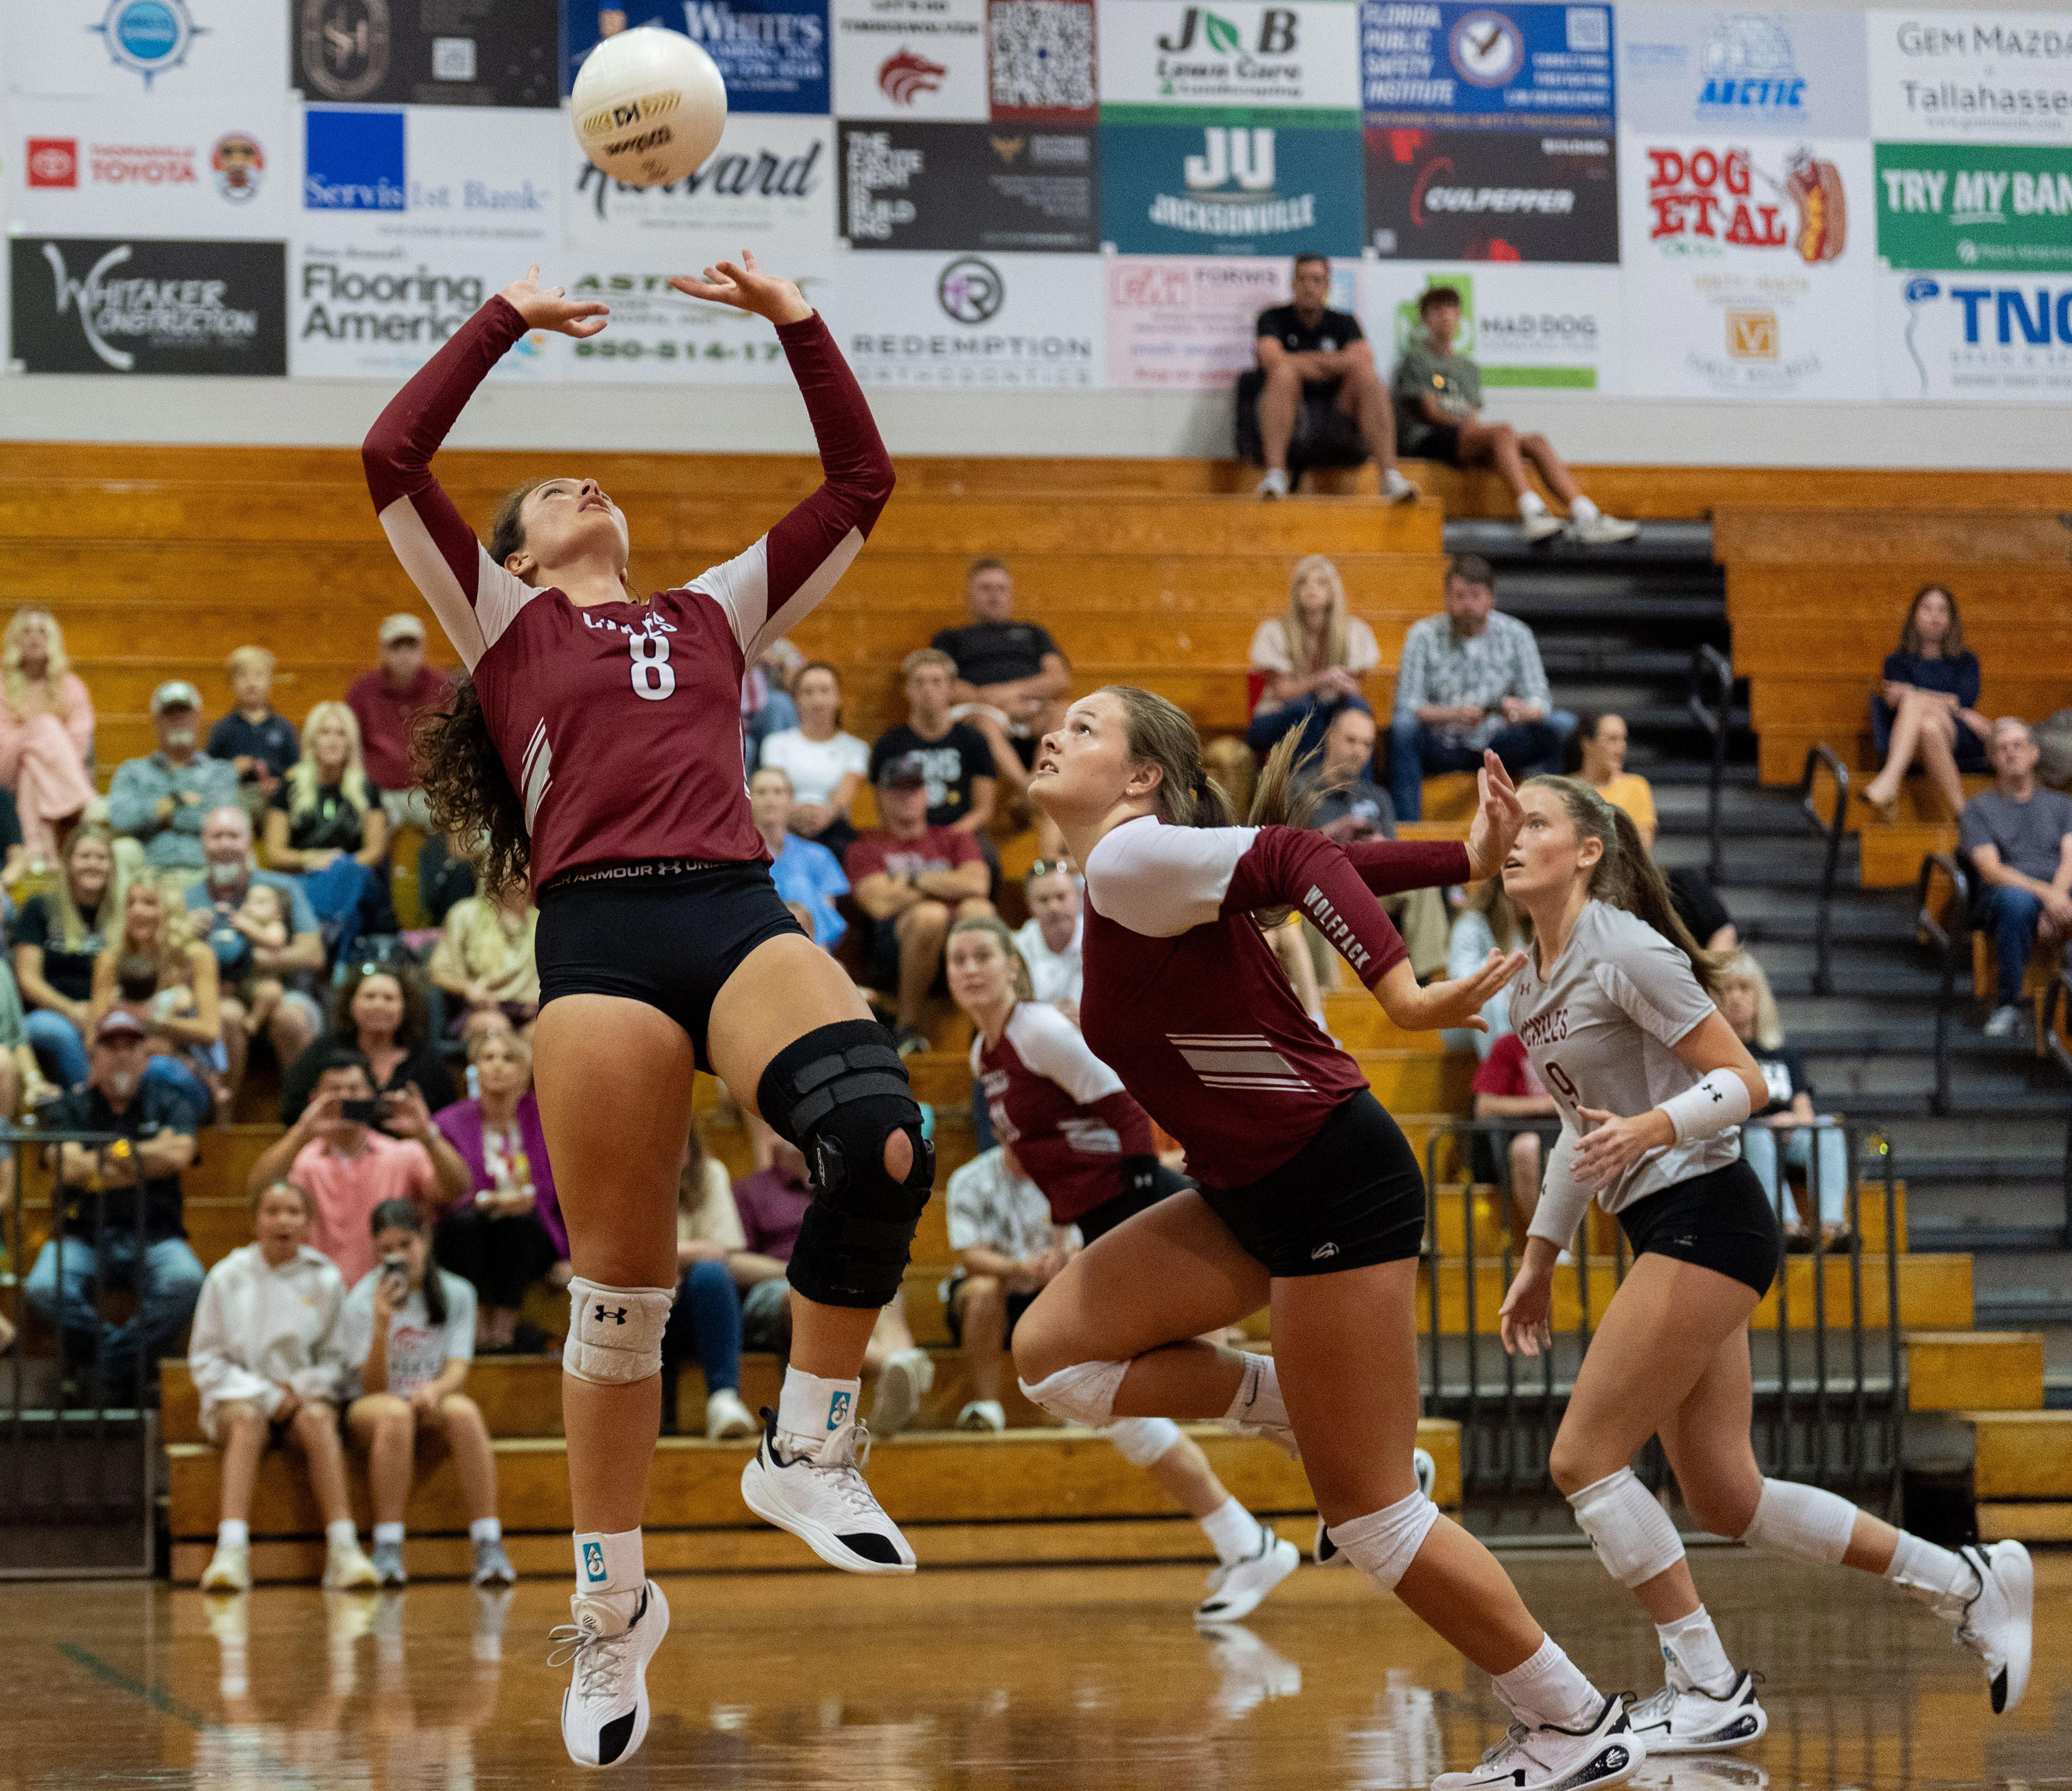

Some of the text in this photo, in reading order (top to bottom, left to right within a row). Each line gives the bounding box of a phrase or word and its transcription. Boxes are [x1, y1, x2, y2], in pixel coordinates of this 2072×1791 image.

[1157, 7, 1299, 53] J B
[1897, 21, 1965, 56] GEM
[1369, 79, 1454, 103] INSTITUTE
[1698, 77, 1806, 105] ARCTIC
[1900, 80, 2072, 113] Tallahasse
[90, 159, 197, 185] TOYOTA
[1185, 128, 1276, 188] JU
[1647, 147, 1751, 196] DOG
[464, 179, 542, 210] Bank
[1425, 186, 1574, 214] CULPEPPER
[1882, 170, 1945, 213] TRY
[1953, 171, 2008, 213] MY
[1148, 194, 1314, 235] JACKSONVILLE
[303, 263, 484, 312] Flooring
[303, 303, 461, 342] Americ
[1540, 314, 1597, 337] DOG
[852, 335, 1092, 358] REDEMPTION
[629, 634, 675, 701] 8
[573, 865, 653, 882] ARMOUR
[1303, 884, 1371, 970] WOLFPACK
